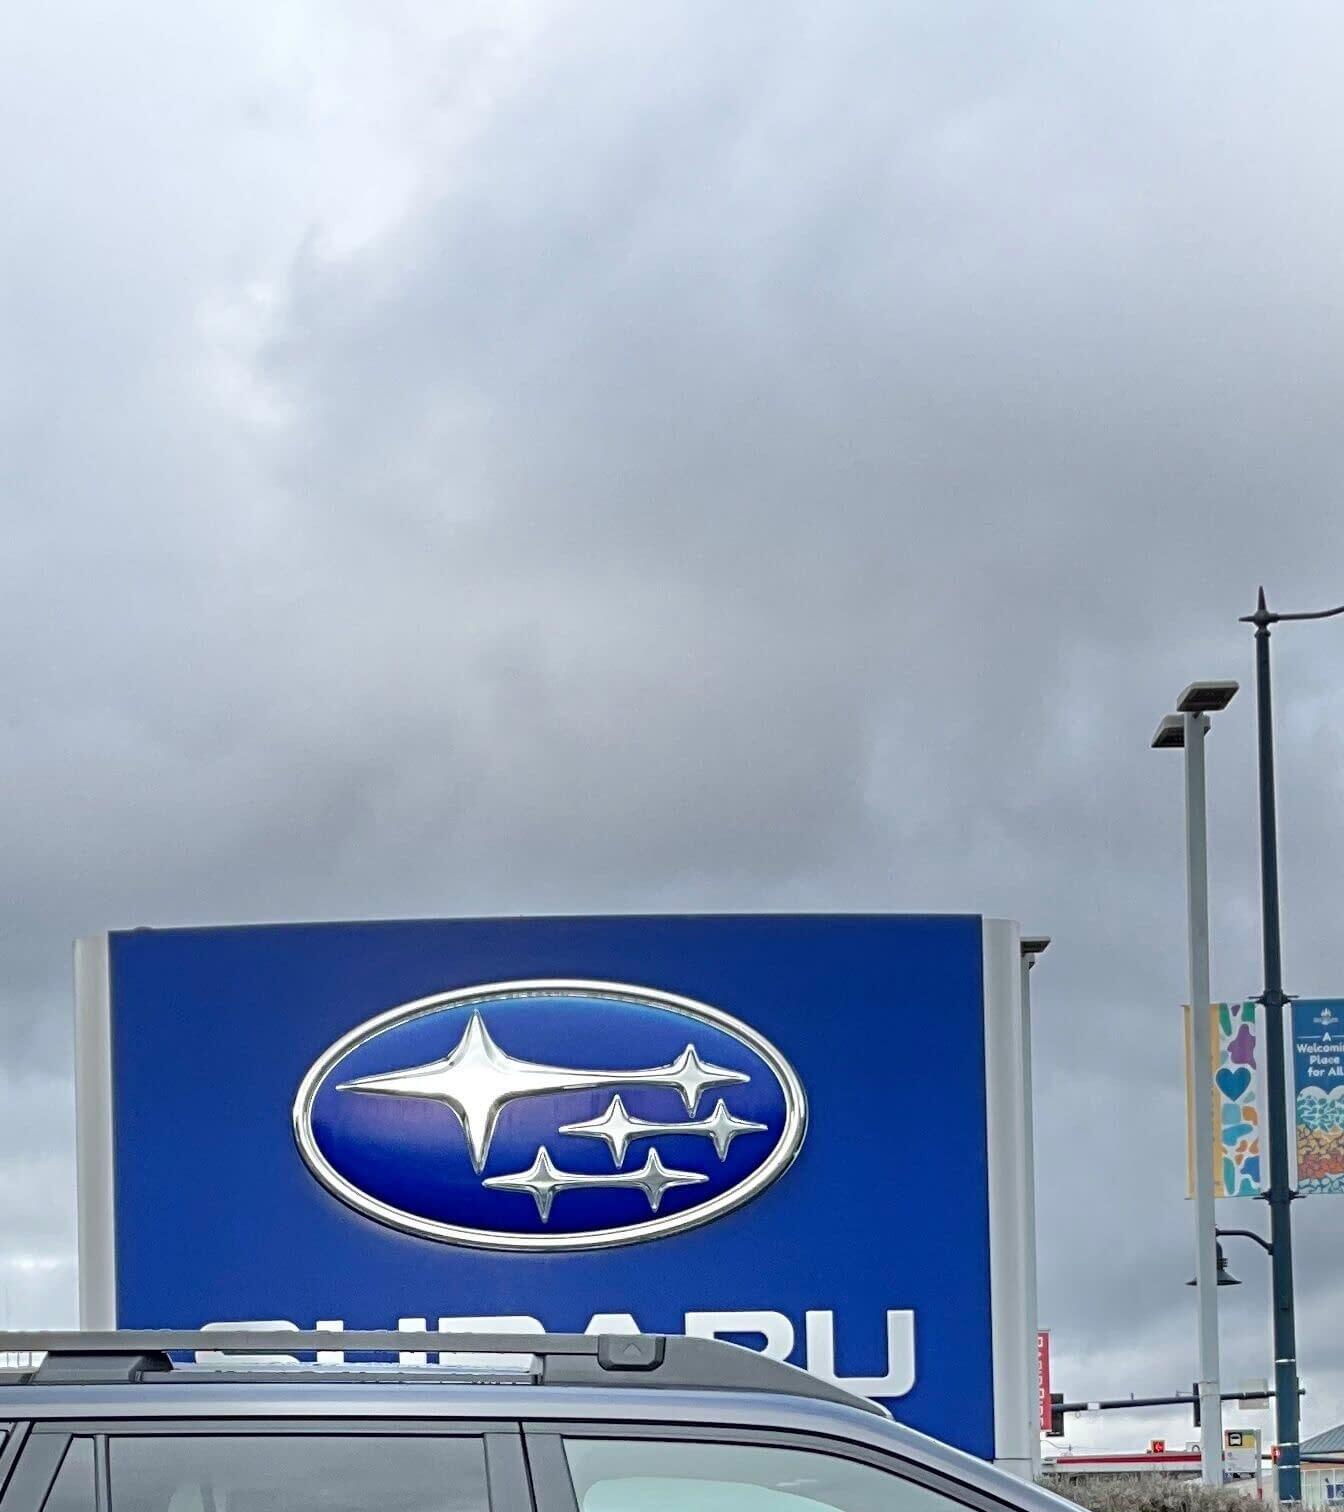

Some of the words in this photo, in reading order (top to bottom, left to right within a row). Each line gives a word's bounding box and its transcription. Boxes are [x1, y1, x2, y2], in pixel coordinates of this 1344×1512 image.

[1322, 1031, 1332, 1042] A
[1309, 1054, 1341, 1065] Place
[1307, 1066, 1325, 1078] for
[1327, 1066, 1344, 1077] All
